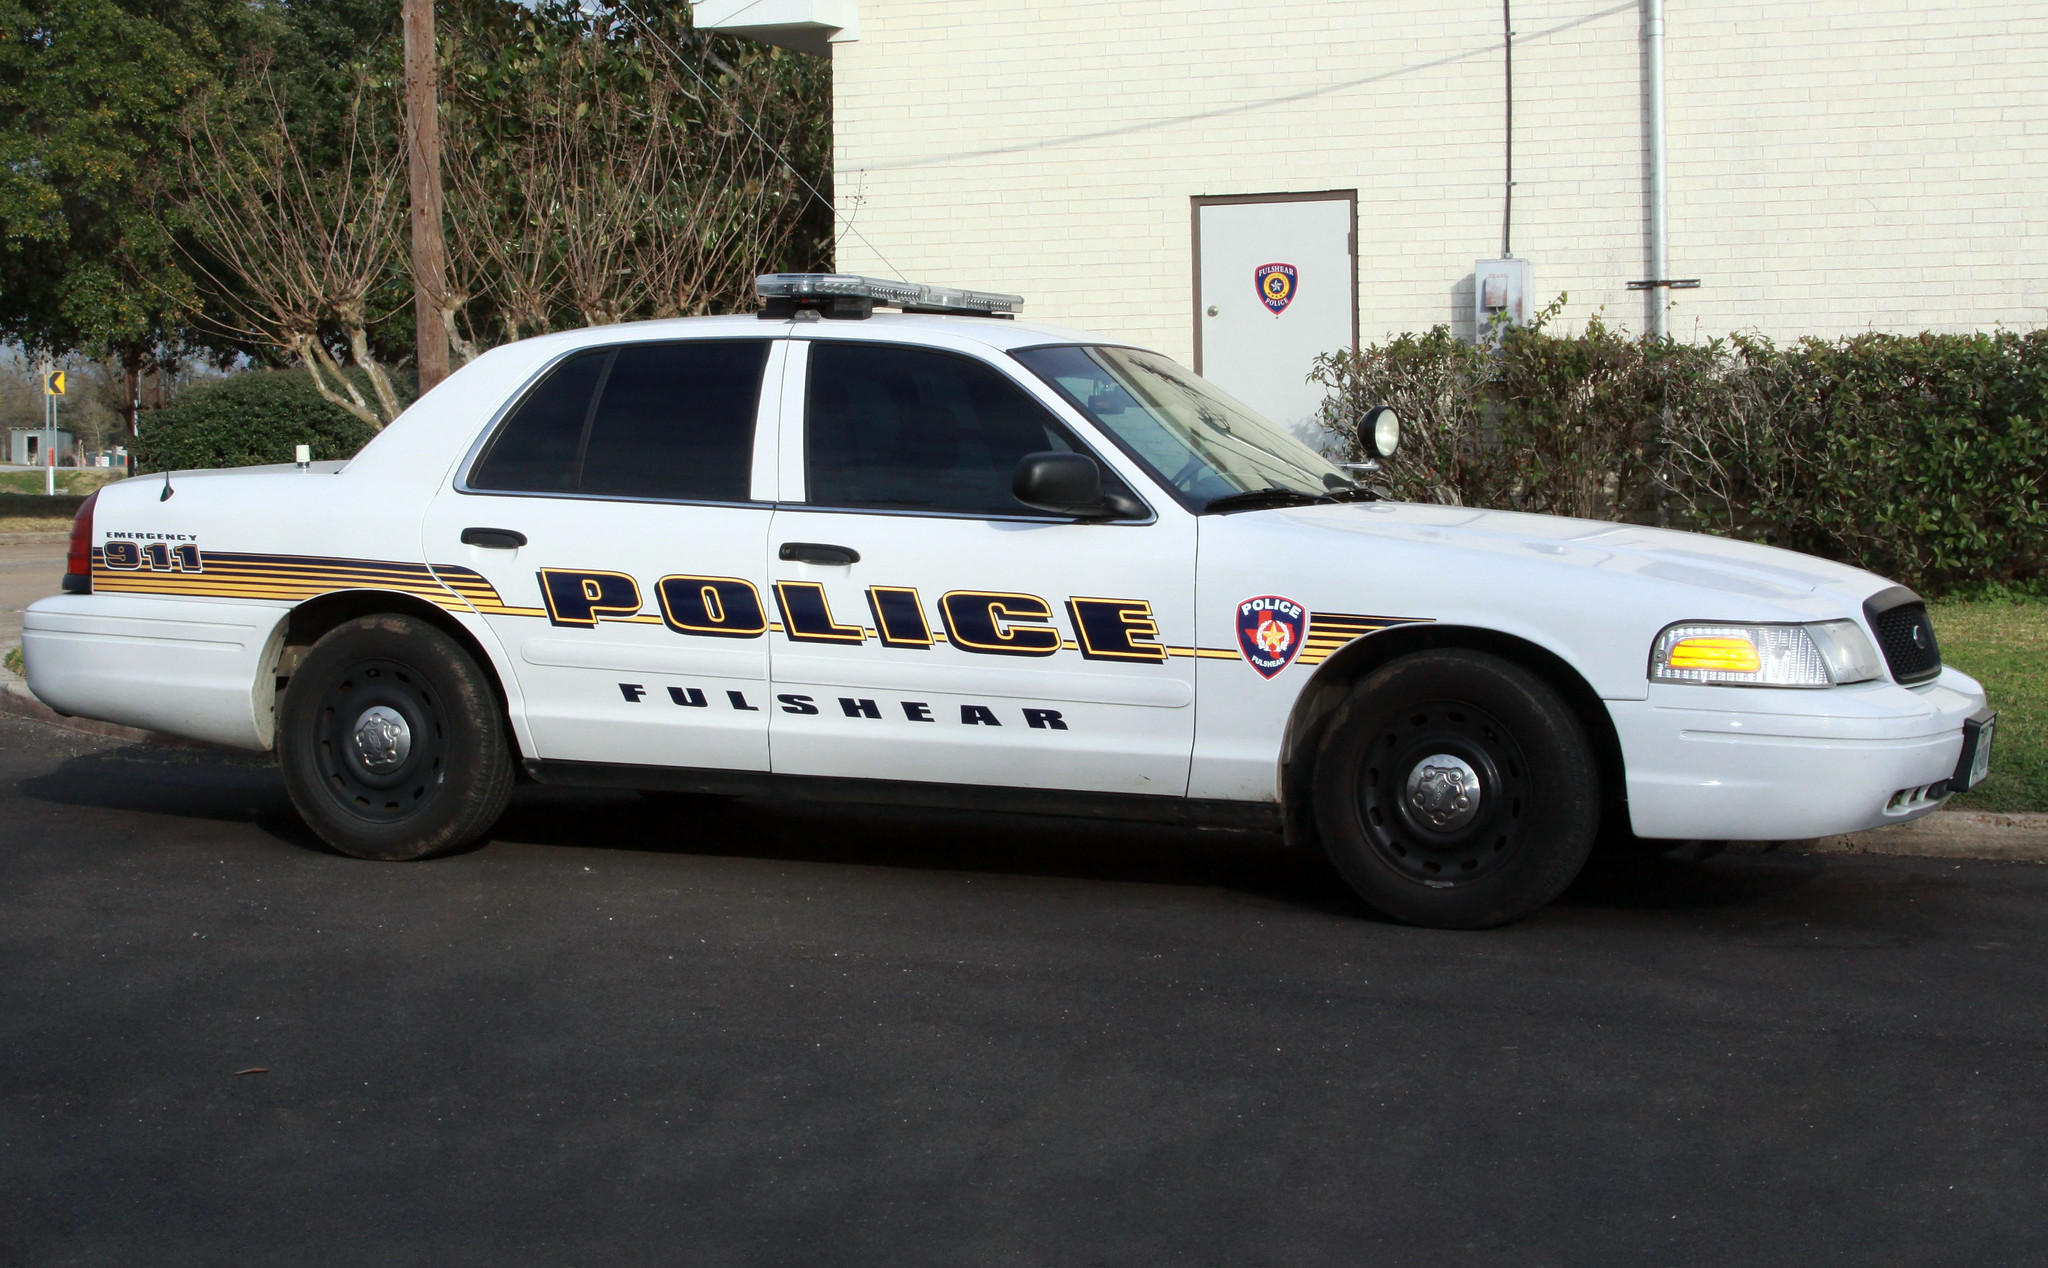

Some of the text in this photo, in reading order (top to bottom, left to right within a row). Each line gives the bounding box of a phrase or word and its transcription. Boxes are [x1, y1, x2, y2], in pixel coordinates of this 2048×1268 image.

[1258, 266, 1294, 277] FULSHEAR
[1265, 297, 1289, 306] POLICE
[106, 531, 198, 541] EMERGENCY
[103, 541, 203, 573] 911
[536, 567, 1169, 663] POLICE
[1241, 598, 1302, 619] POLICE
[1251, 655, 1285, 667] FULSHEAR
[618, 682, 1070, 731] FULSHEAR
